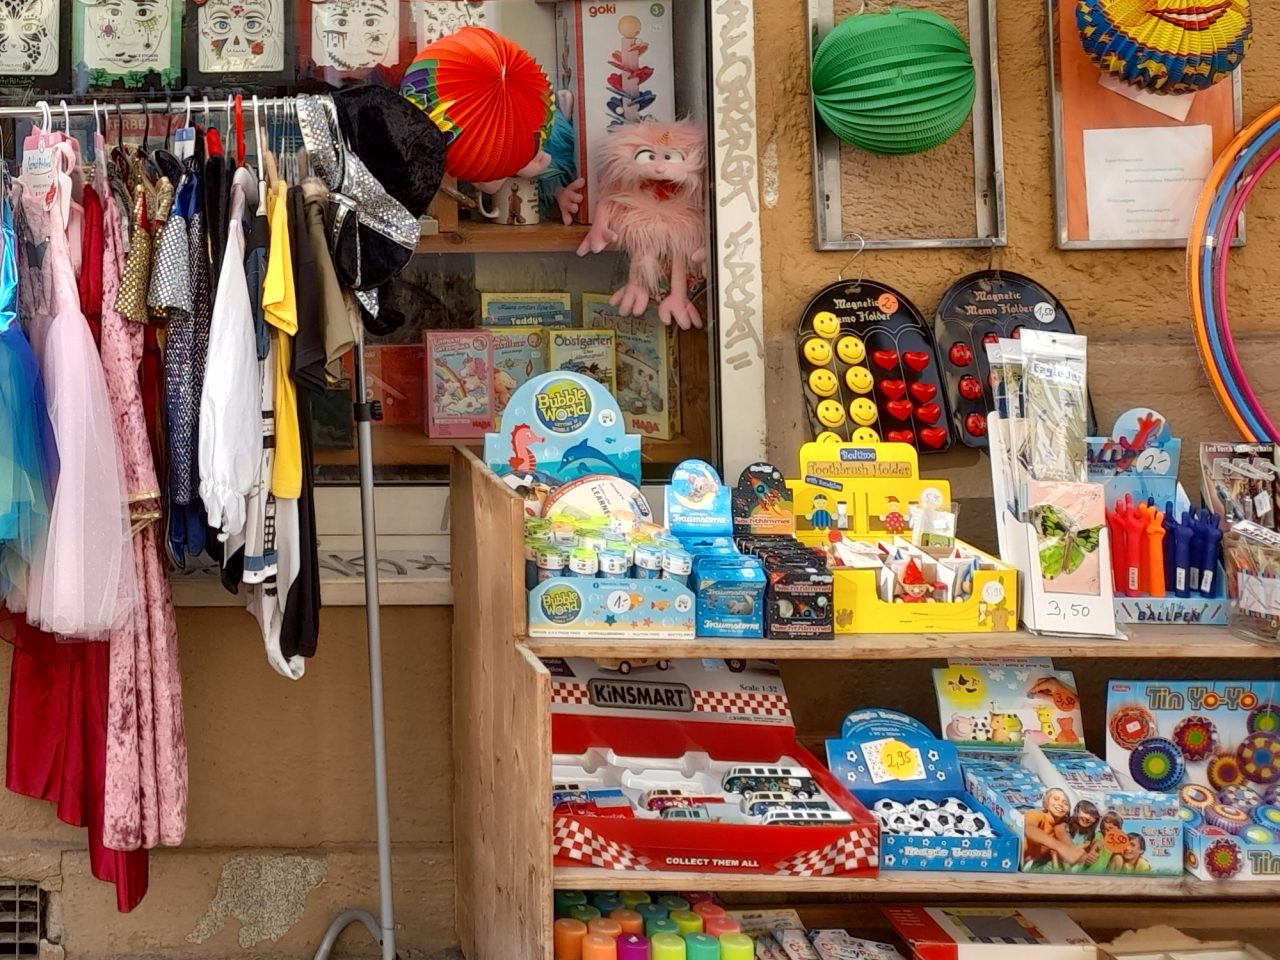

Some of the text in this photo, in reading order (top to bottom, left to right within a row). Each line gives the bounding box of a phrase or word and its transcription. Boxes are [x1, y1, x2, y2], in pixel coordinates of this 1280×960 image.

[589, 3, 616, 17] goki
[974, 290, 1021, 302] Magnetic
[965, 303, 1034, 315] Memo Holder
[511, 316, 543, 326] Teddys
[833, 312, 890, 323] emo Holder
[554, 333, 613, 349] Obstgarten
[536, 388, 587, 410] Bubble
[541, 402, 589, 422] World
[632, 419, 660, 433] HABA
[841, 449, 875, 461] Bedtime
[809, 461, 910, 477] Toothbrush Holder
[734, 516, 790, 525] Nachthimmel
[542, 590, 579, 606] Bubble
[546, 602, 580, 615] World
[1046, 600, 1090, 619] 3,50
[1138, 609, 1201, 623] BALLPEN
[739, 683, 759, 692] Scale
[593, 683, 684, 707] KiNSMART
[1146, 687, 1258, 711] Tin Yo-Yo
[886, 748, 912, 777] 2,95
[666, 856, 760, 868] COLLECT THEM ALL
